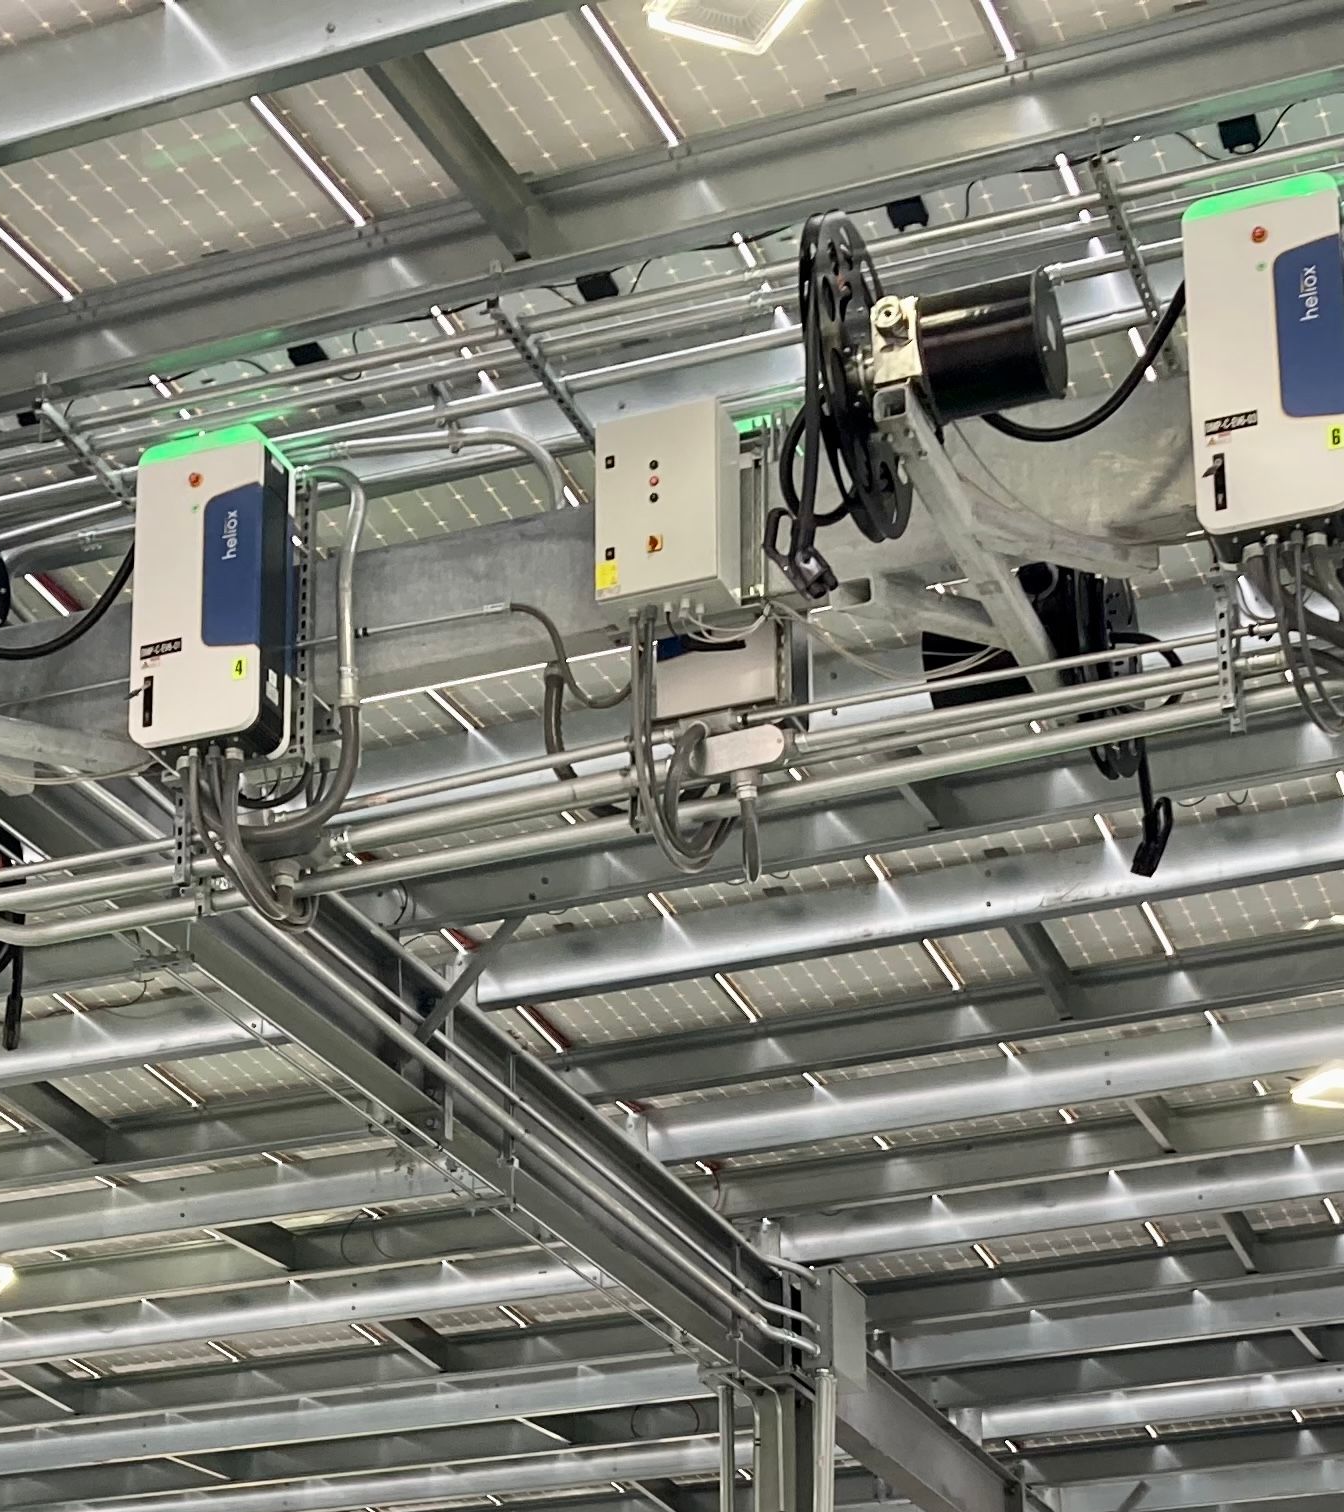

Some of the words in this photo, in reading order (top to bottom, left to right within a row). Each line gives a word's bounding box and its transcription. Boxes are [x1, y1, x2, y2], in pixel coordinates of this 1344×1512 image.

[1298, 264, 1319, 322] heliox
[1332, 428, 1341, 445] 6
[221, 509, 238, 560] heliox
[235, 660, 243, 675] 4
